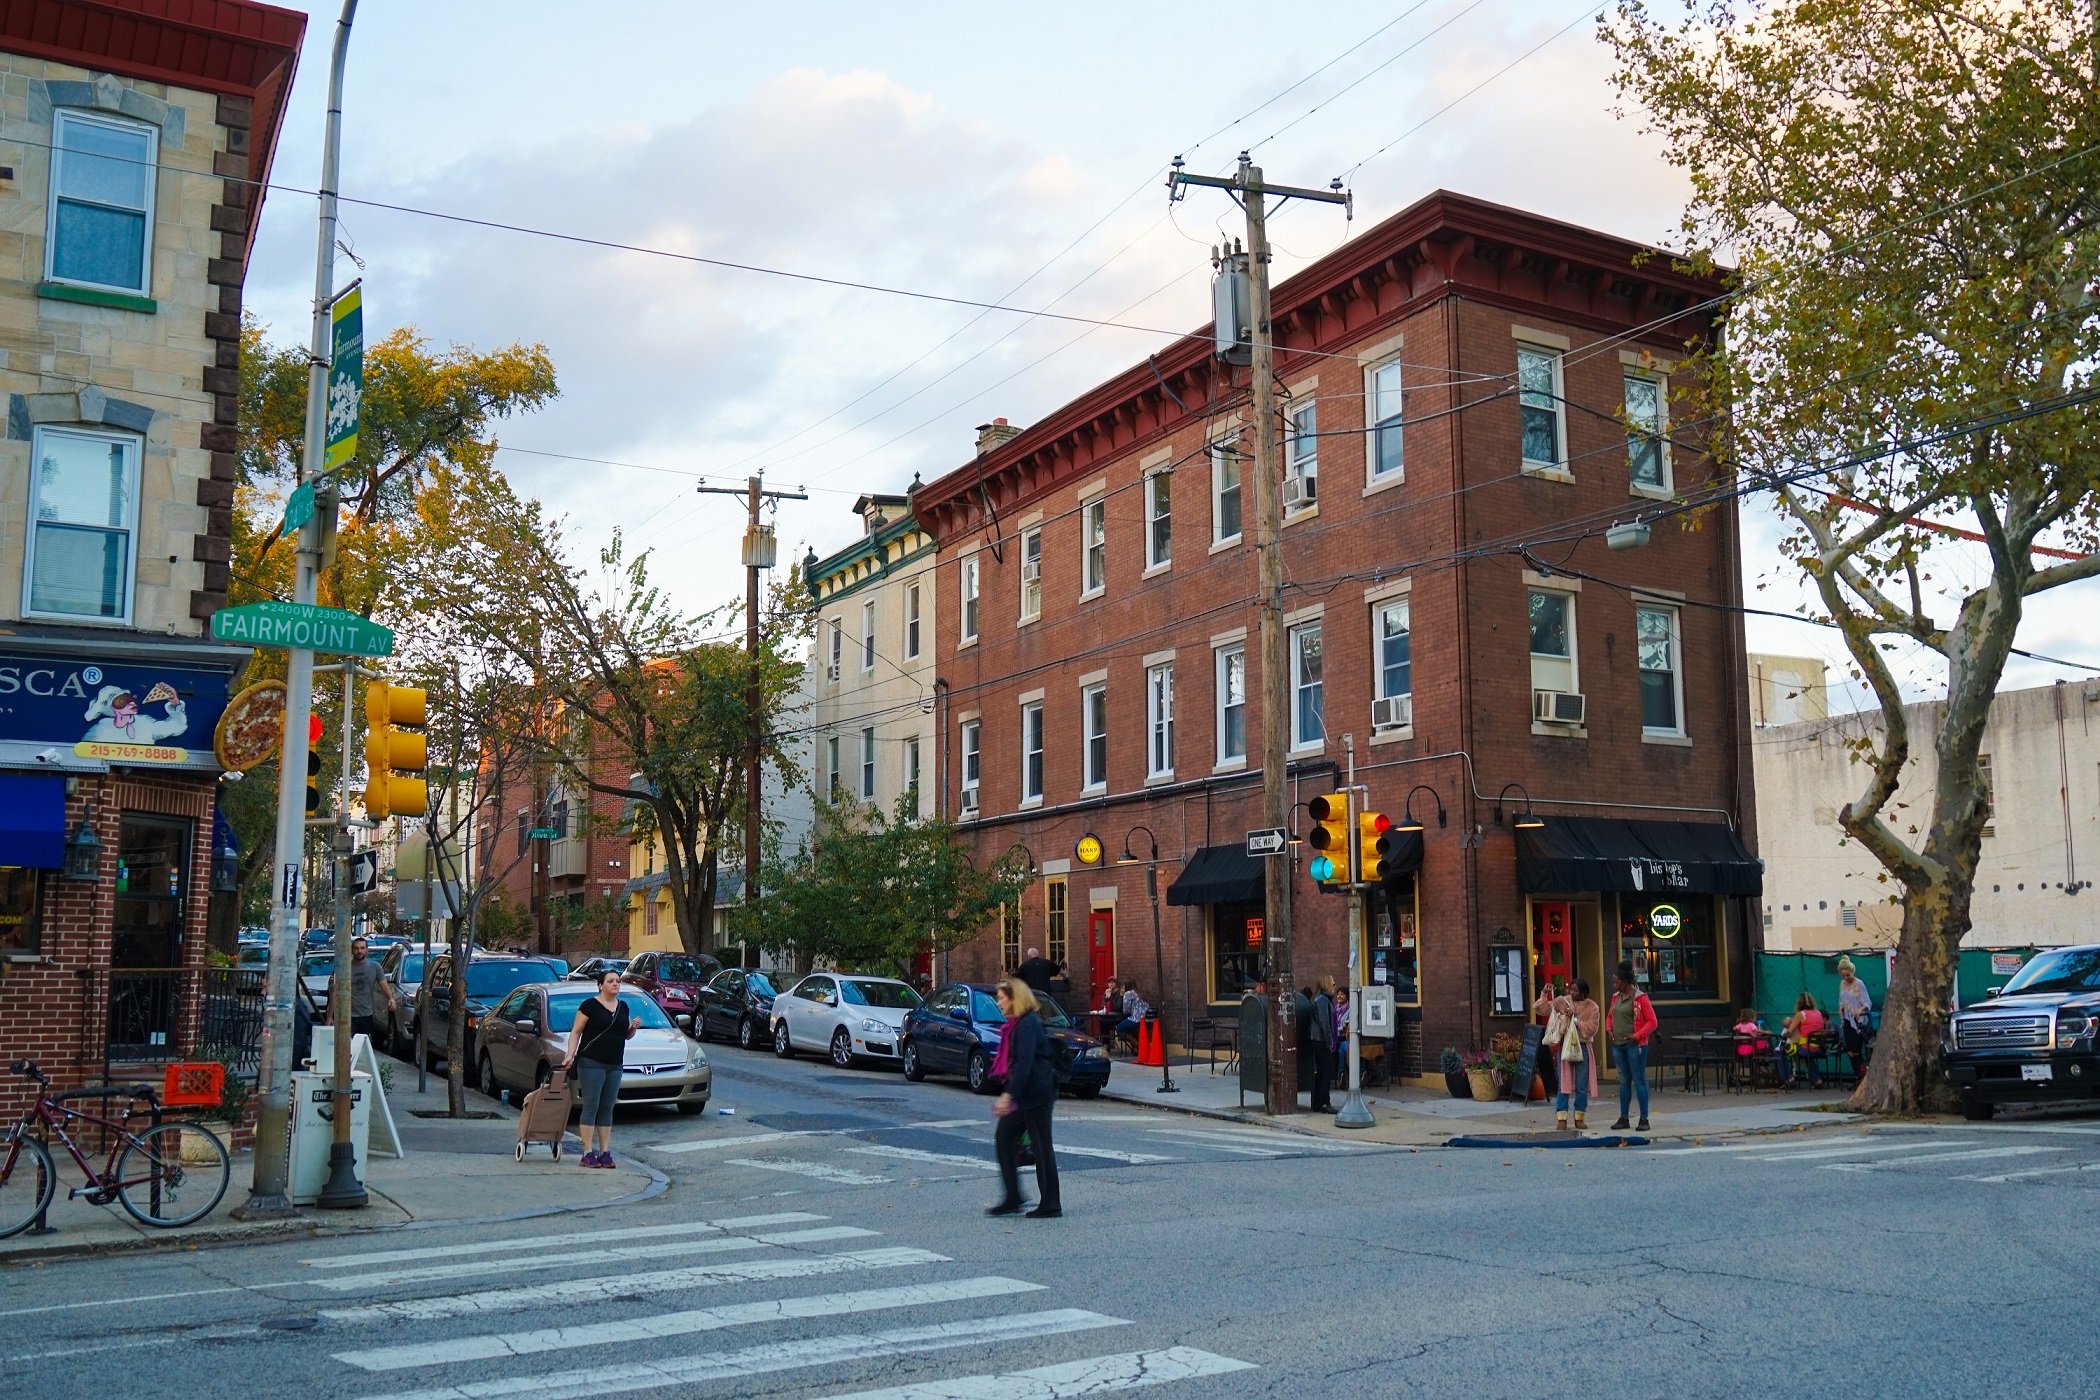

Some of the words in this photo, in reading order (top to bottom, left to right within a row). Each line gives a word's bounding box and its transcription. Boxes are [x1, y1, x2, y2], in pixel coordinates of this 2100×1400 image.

[271, 603, 300, 615] 2400
[302, 606, 314, 619] W
[317, 609, 346, 621] 2300
[221, 612, 359, 649] FAIRMOUNT
[367, 636, 387, 652] AV
[90, 744, 177, 760] 215-769-8888
[1251, 837, 1262, 848] ONE
[1263, 836, 1274, 848] WAY
[1652, 915, 1679, 927] YARDS
[313, 1091, 328, 1101] The
